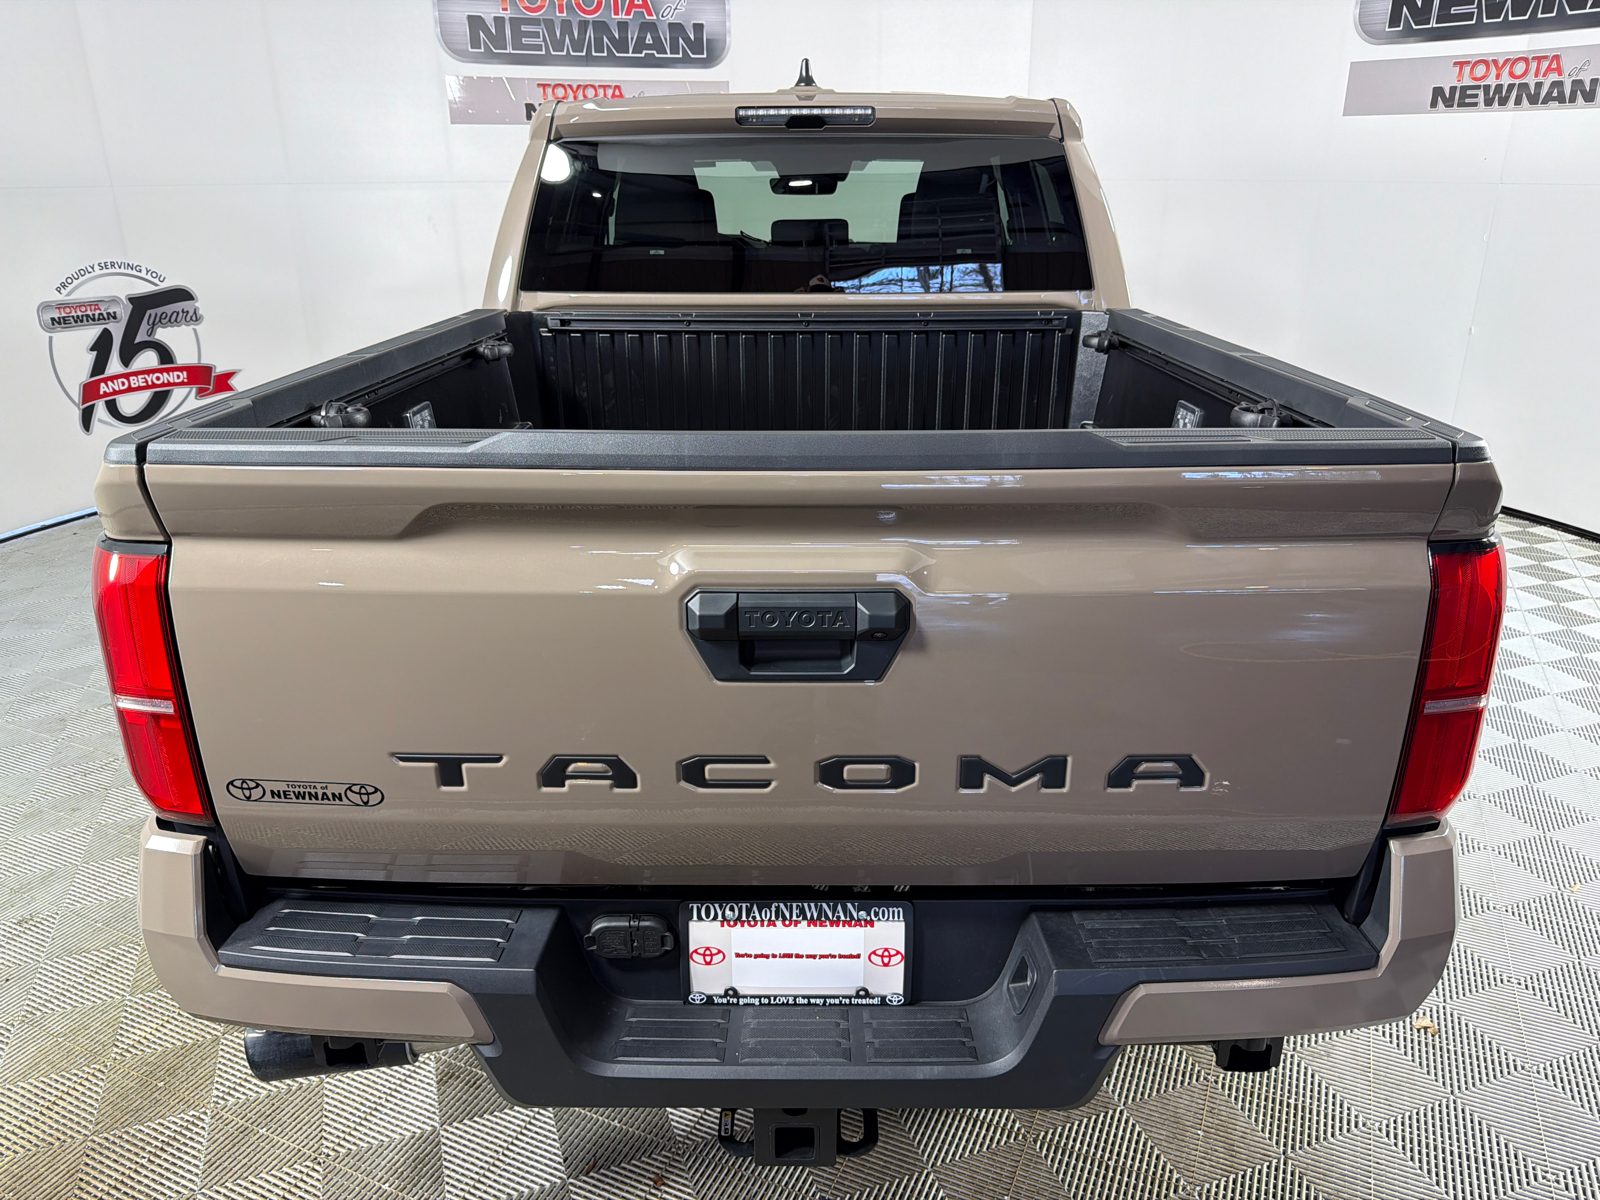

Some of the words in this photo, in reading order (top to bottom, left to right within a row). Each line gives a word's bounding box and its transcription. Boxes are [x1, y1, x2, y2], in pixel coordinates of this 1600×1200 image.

[466, 14, 707, 58] NEWNAN
[1452, 53, 1564, 83] TOYOTA
[1567, 59, 1591, 78] of
[536, 83, 625, 101] TOYOTA
[1429, 77, 1600, 110] NEWNAN
[55, 264, 95, 295] PROUDLY
[98, 261, 142, 273] SERVING
[145, 267, 166, 283] YOU
[50, 311, 117, 326] NEWNAN
[55, 303, 102, 315] TOYOTA
[145, 306, 201, 337] years
[100, 377, 129, 395] AND
[130, 371, 188, 388] BEYOND!
[744, 610, 850, 628] TOYOTA
[389, 753, 1210, 793] TACOMA
[270, 789, 344, 802] NEWNAN
[713, 996, 737, 1004] You're
[739, 997, 759, 1006] going
[761, 997, 769, 1005] to
[770, 996, 794, 1005] LOVE
[796, 997, 808, 1005] the
[809, 998, 824, 1006] way
[826, 997, 850, 1006] you're
[851, 997, 881, 1005] treated!
